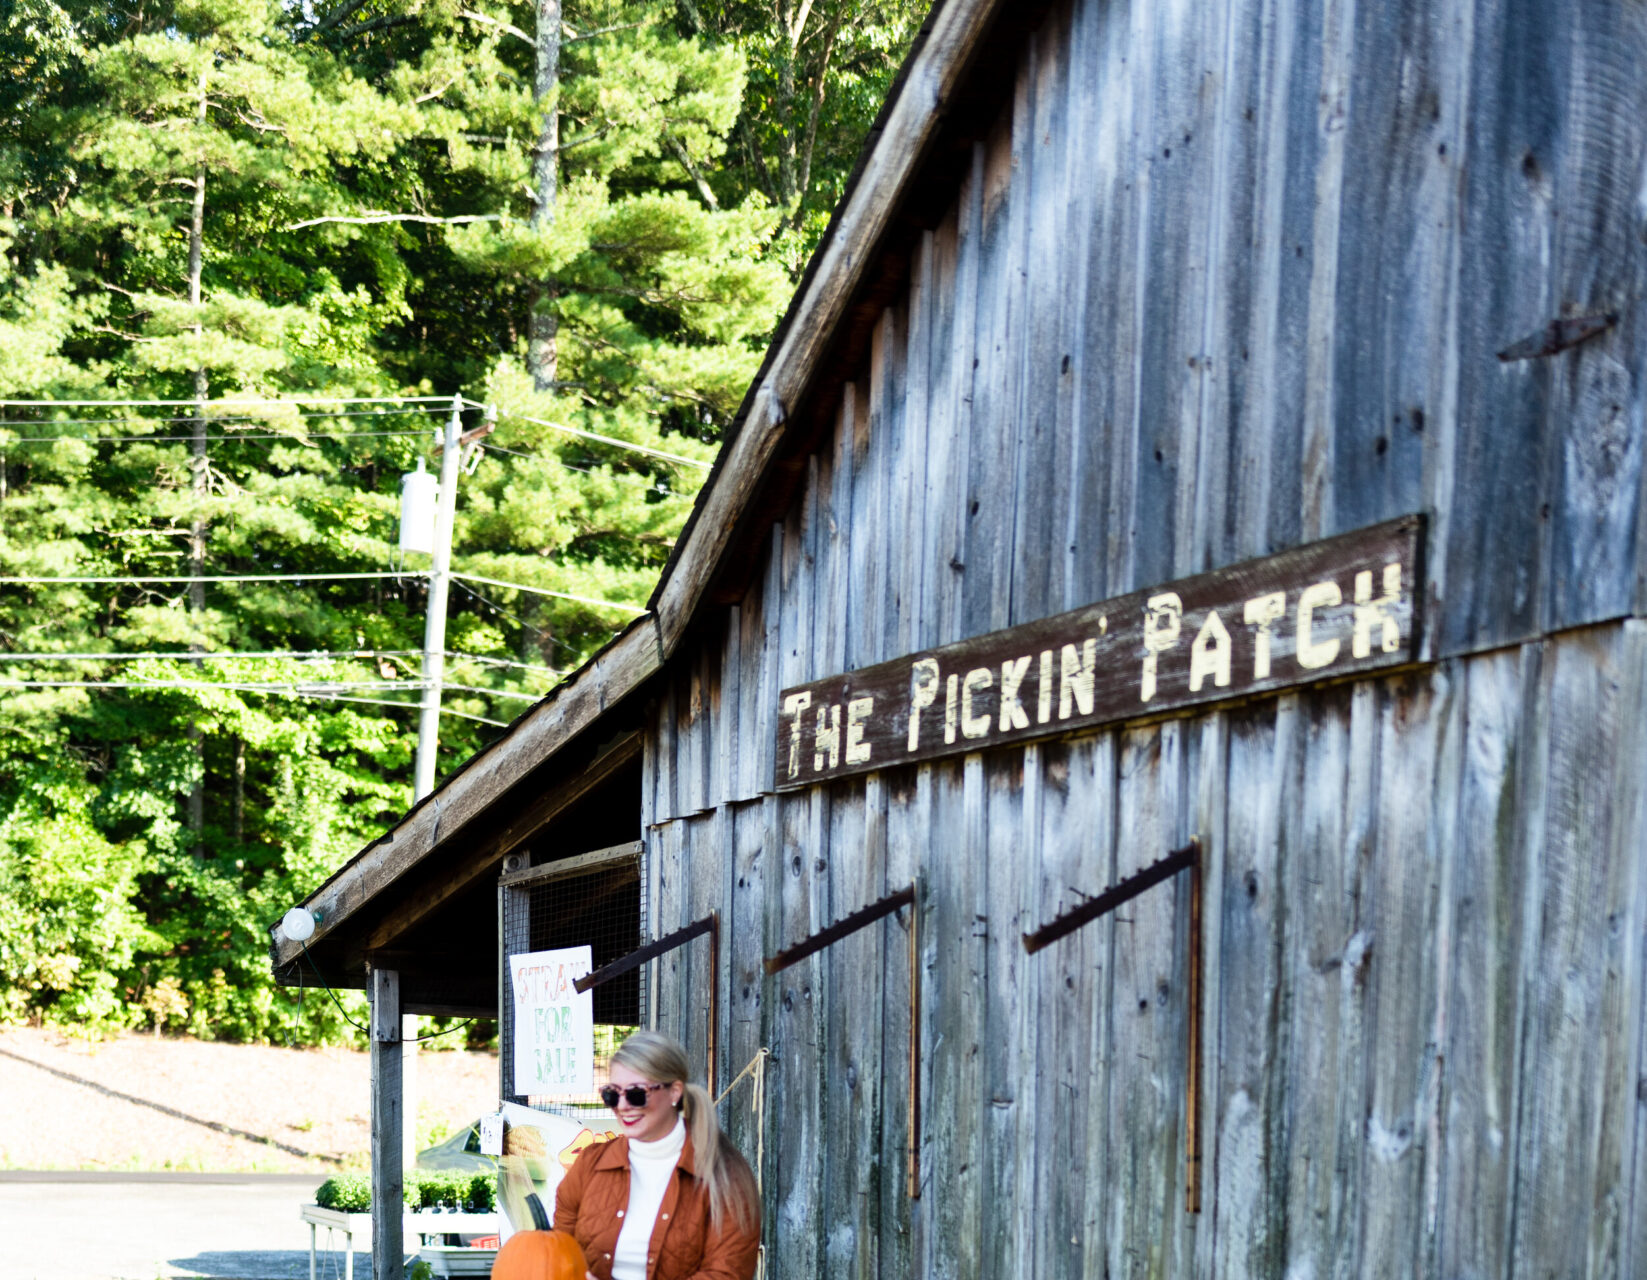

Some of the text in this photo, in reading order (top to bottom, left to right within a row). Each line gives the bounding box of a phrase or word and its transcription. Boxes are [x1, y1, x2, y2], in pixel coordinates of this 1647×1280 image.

[784, 691, 872, 778] THE
[1140, 563, 1402, 703] PATCH
[535, 1006, 574, 1043] FOR
[535, 1047, 576, 1084] SALE
